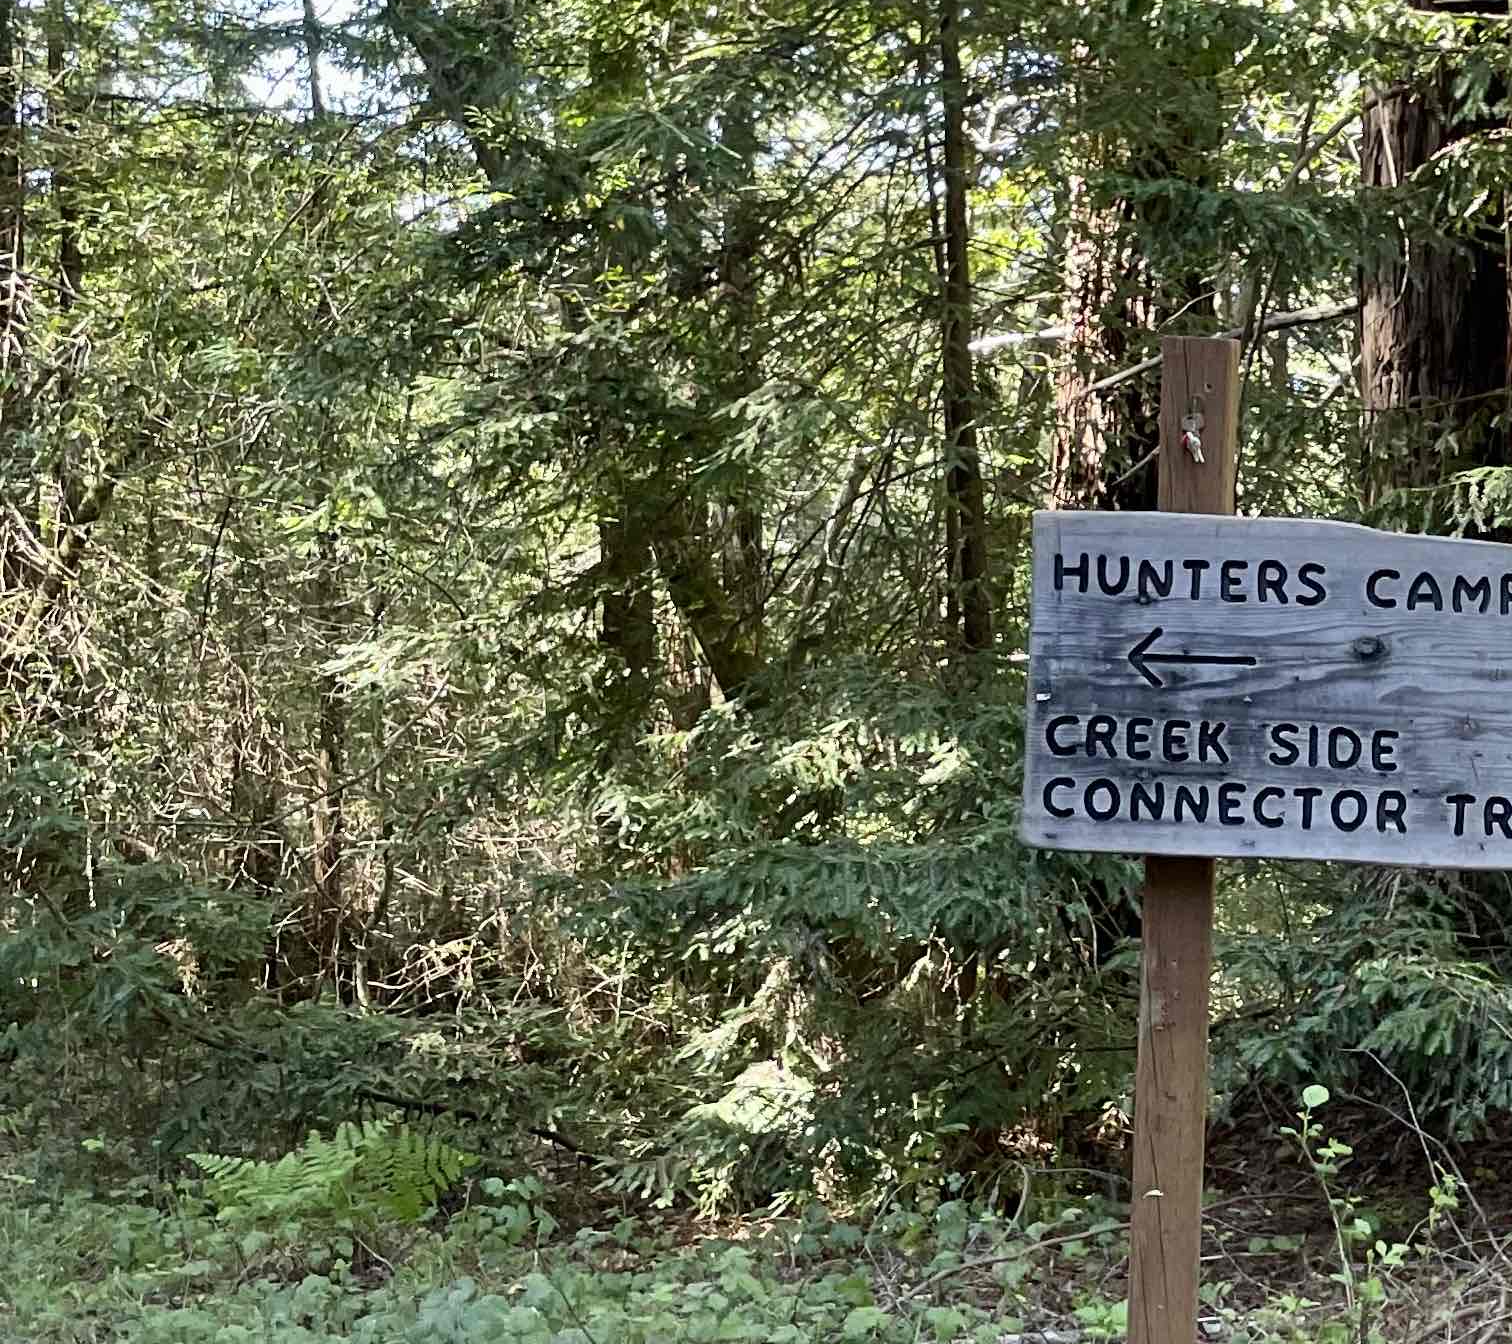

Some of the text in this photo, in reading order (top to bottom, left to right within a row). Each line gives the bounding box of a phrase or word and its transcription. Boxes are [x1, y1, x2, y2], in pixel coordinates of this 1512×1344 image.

[1054, 552, 1328, 606] HUNTERS
[1045, 714, 1400, 772] CREEK SIDE
[1042, 776, 1408, 834] CONNECTOR
